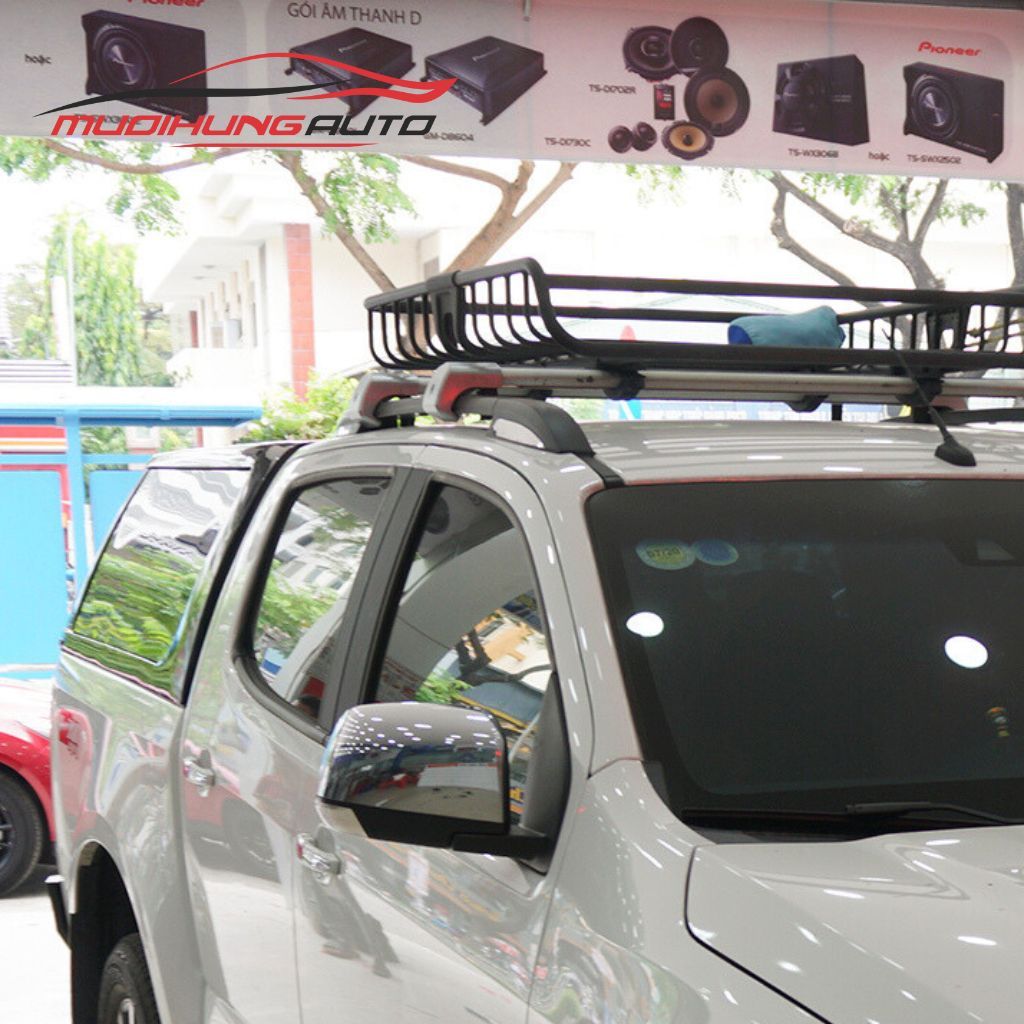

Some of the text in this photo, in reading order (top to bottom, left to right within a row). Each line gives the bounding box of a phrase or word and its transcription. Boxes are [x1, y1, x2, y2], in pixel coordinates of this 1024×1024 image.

[287, 1, 423, 26] GÓI ÂM THANH D
[917, 40, 982, 57] Pioneer
